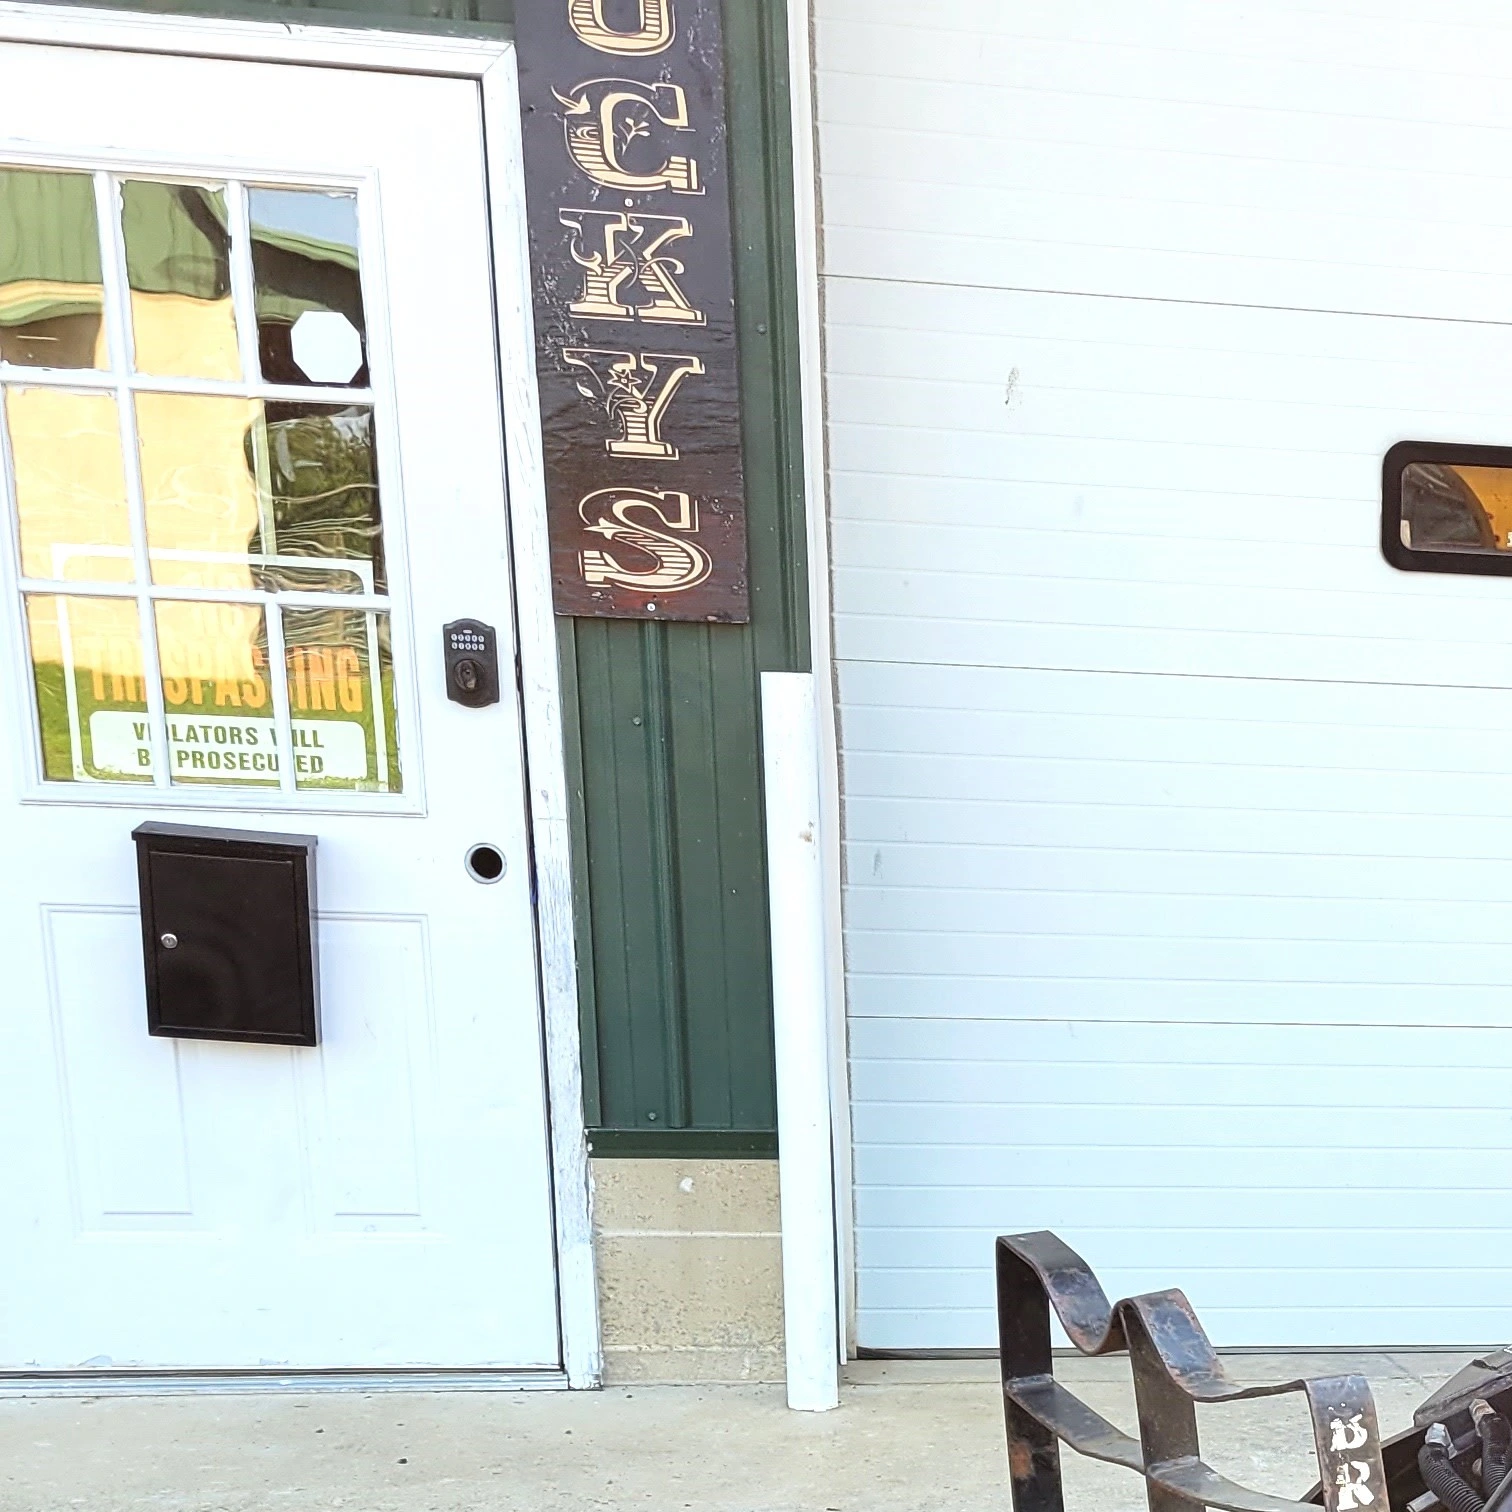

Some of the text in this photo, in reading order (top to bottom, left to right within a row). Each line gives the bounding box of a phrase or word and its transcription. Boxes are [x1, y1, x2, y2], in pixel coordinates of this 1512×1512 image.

[82, 637, 364, 713] TRSPASING
[132, 722, 259, 745] VLATORS
[137, 748, 324, 774] B PROSECUED
